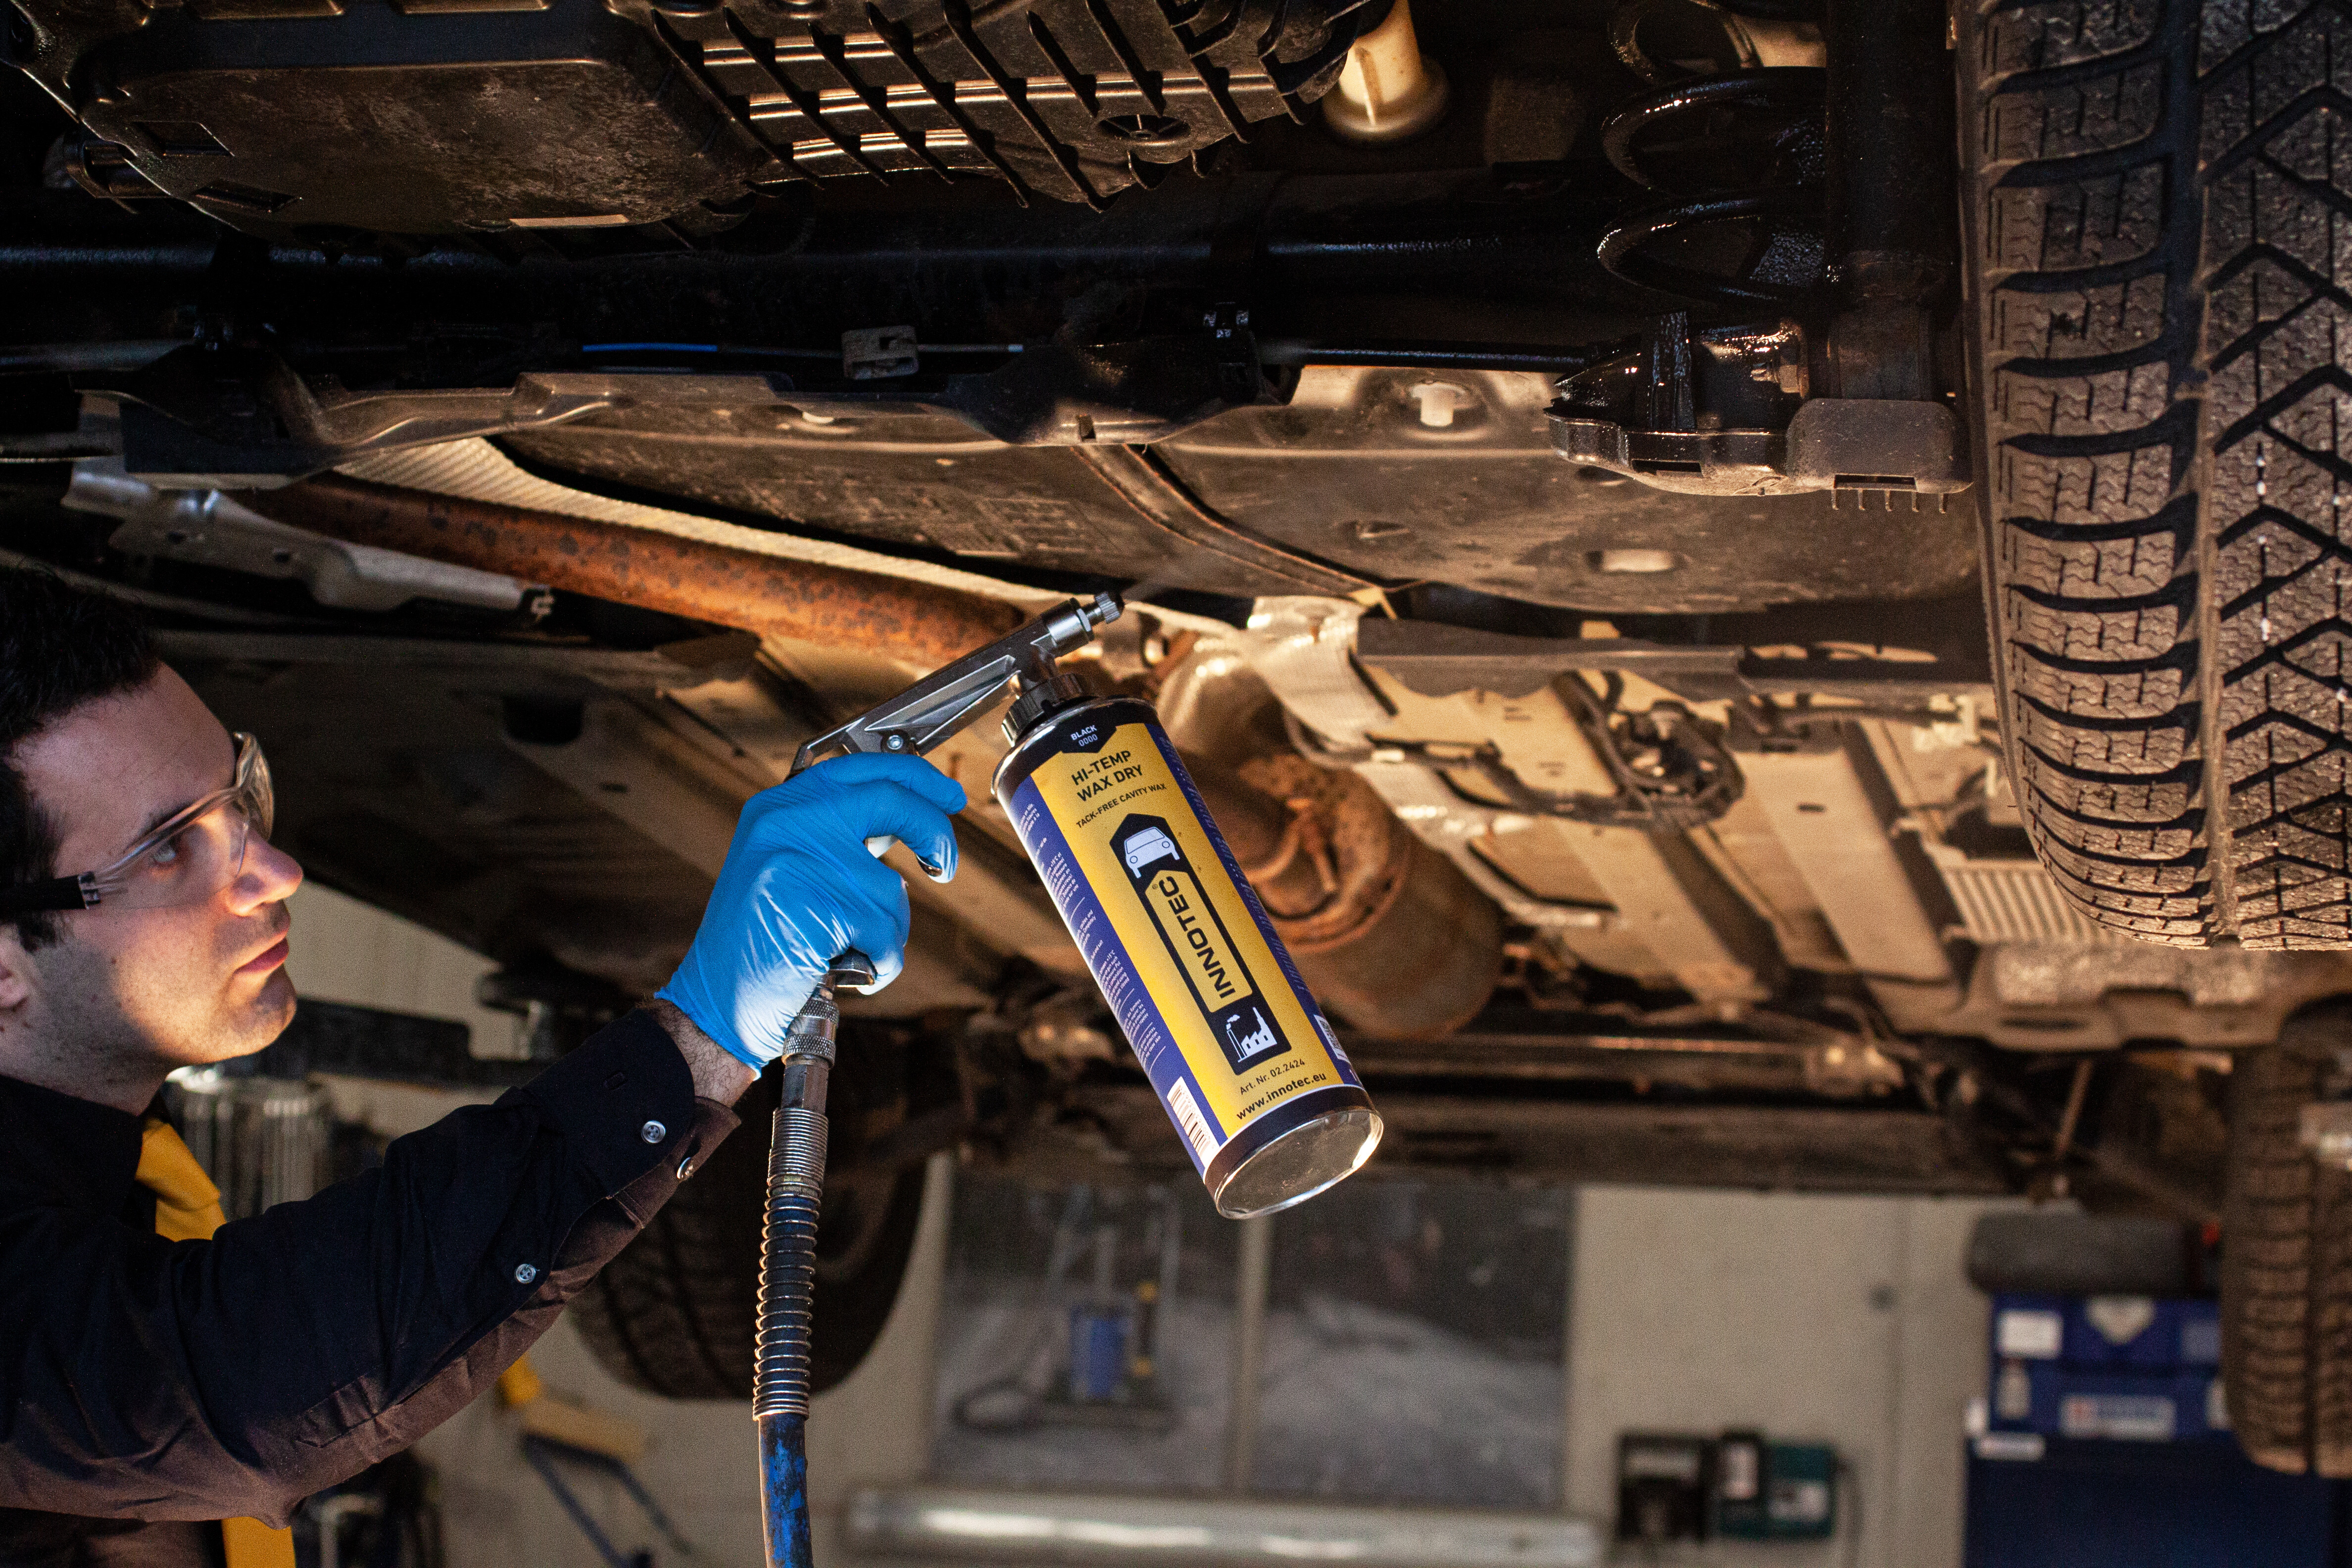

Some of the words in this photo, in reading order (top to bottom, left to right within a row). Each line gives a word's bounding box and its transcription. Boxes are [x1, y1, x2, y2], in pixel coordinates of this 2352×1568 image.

[1071, 725, 1097, 740] BLACK
[1078, 734, 1098, 746] 0000
[1071, 750, 1131, 785] HI-TEMP
[1077, 776, 1113, 801] WAX
[1114, 764, 1143, 783] DRY
[1076, 798, 1119, 828] TACK-FREE
[1120, 786, 1147, 802] CAVITY
[1148, 783, 1167, 792] WAX
[1159, 876, 1236, 998] INNOTEC
[1240, 1082, 1256, 1095] Art.
[1256, 1075, 1270, 1084] Nr.
[1270, 1058, 1305, 1078] 02.2424
[1236, 1073, 1326, 1120] www.innotec.eu
